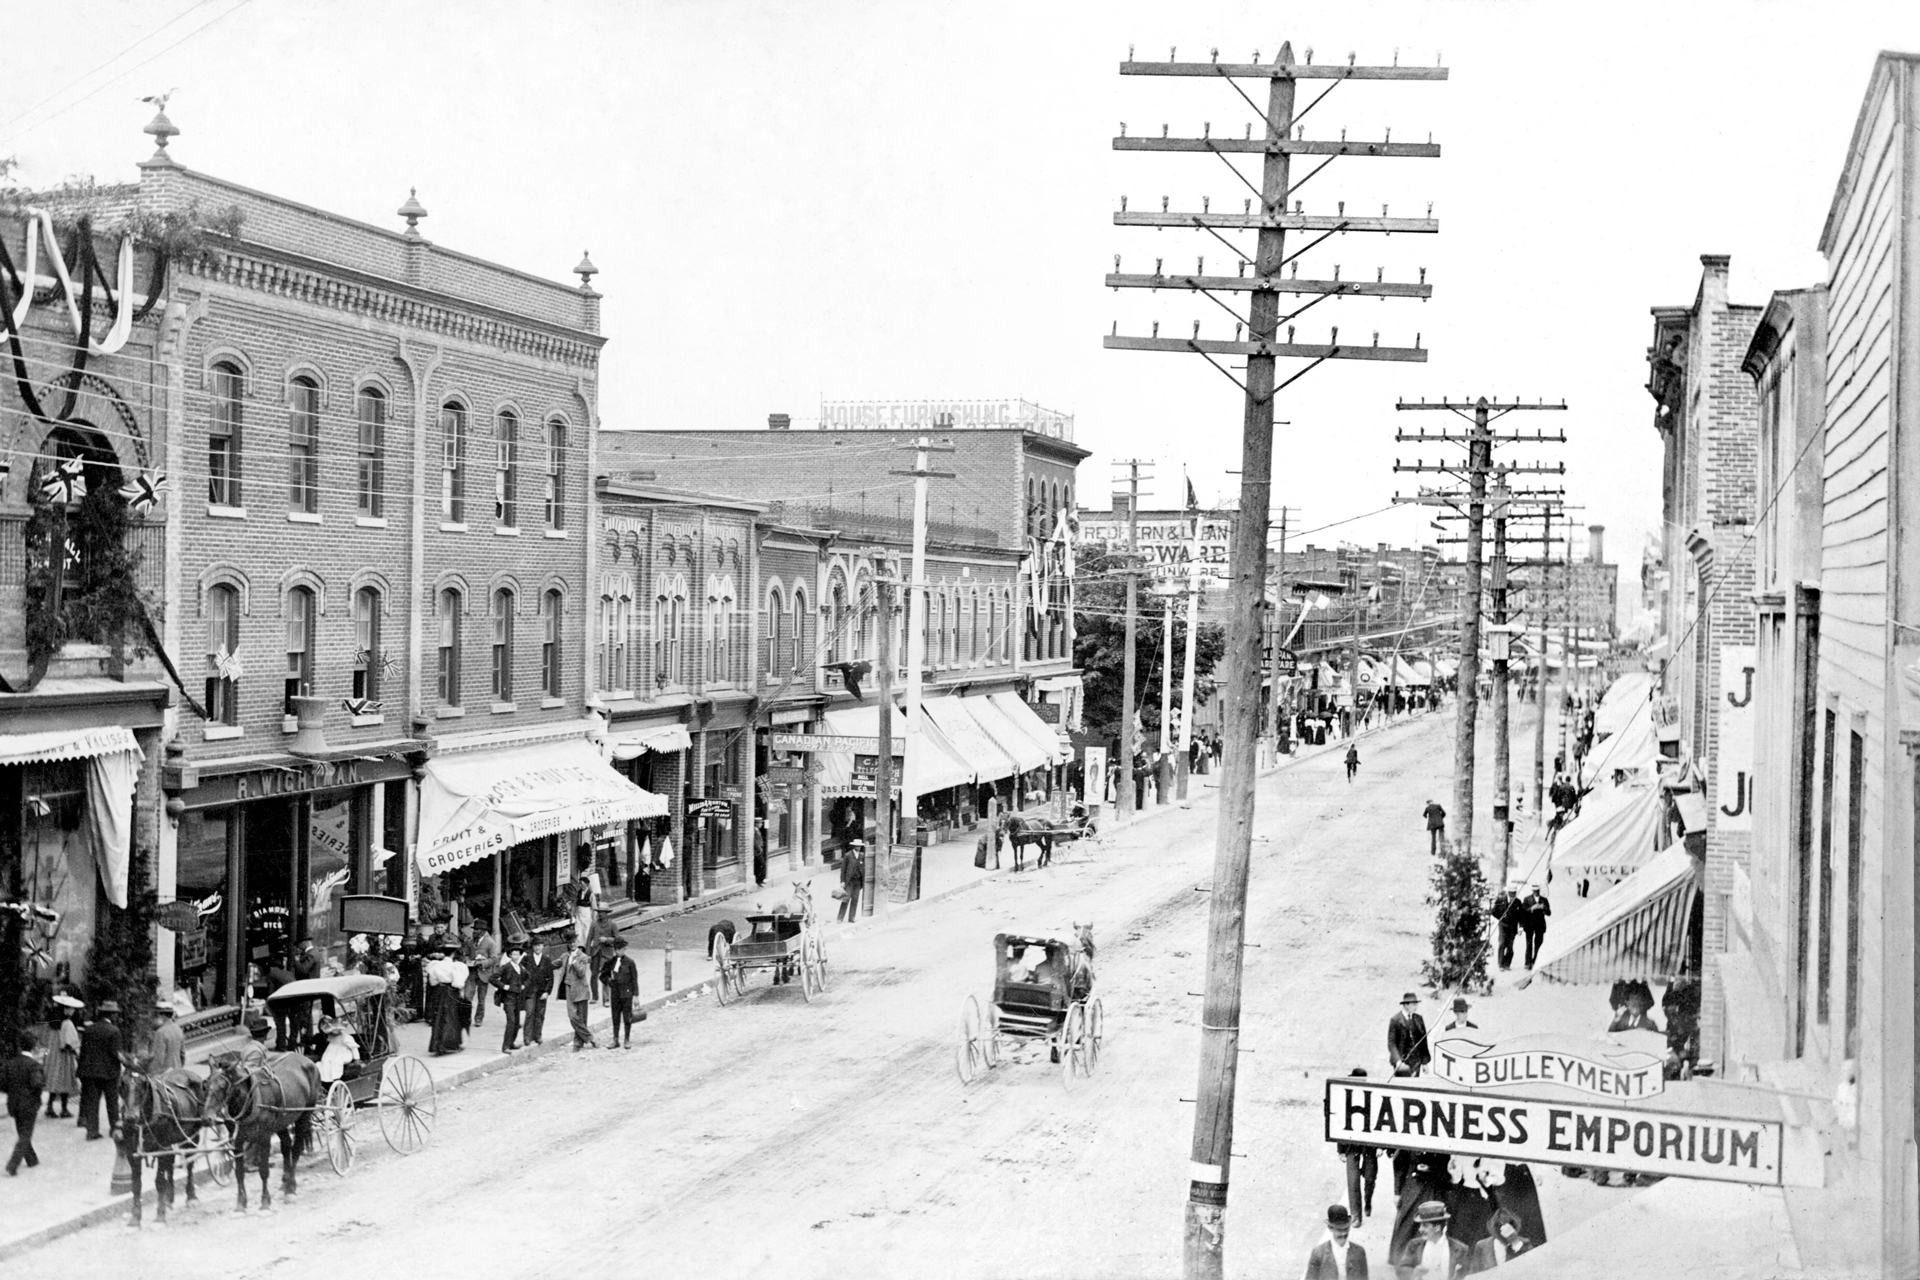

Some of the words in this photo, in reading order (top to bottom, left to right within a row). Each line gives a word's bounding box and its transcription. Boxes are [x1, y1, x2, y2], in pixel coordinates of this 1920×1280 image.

[823, 404, 887, 426] HOUSE
[890, 403, 1010, 426] FURNISHING
[1167, 526, 1179, 540] &
[1181, 525, 1228, 540] LPAN
[1155, 566, 1224, 577] TINWRE.
[1260, 660, 1295, 669] ARDARE
[84, 732, 130, 749] VALISES
[774, 734, 831, 745] CANADIAN
[834, 736, 878, 747] PACIFIC
[530, 816, 561, 832] GROCERIES
[432, 828, 472, 847] FRUIT
[477, 825, 487, 835] &
[427, 833, 503, 868] GROCERIES
[560, 832, 569, 869] OYSTERS
[410, 862, 419, 902] OYSTERS
[1441, 1053, 1464, 1082] T.
[1475, 1055, 1657, 1096] BULLEYMENT.
[1343, 1088, 1529, 1145] HARNESS
[1547, 1109, 1773, 1171] EMPORIUM.
